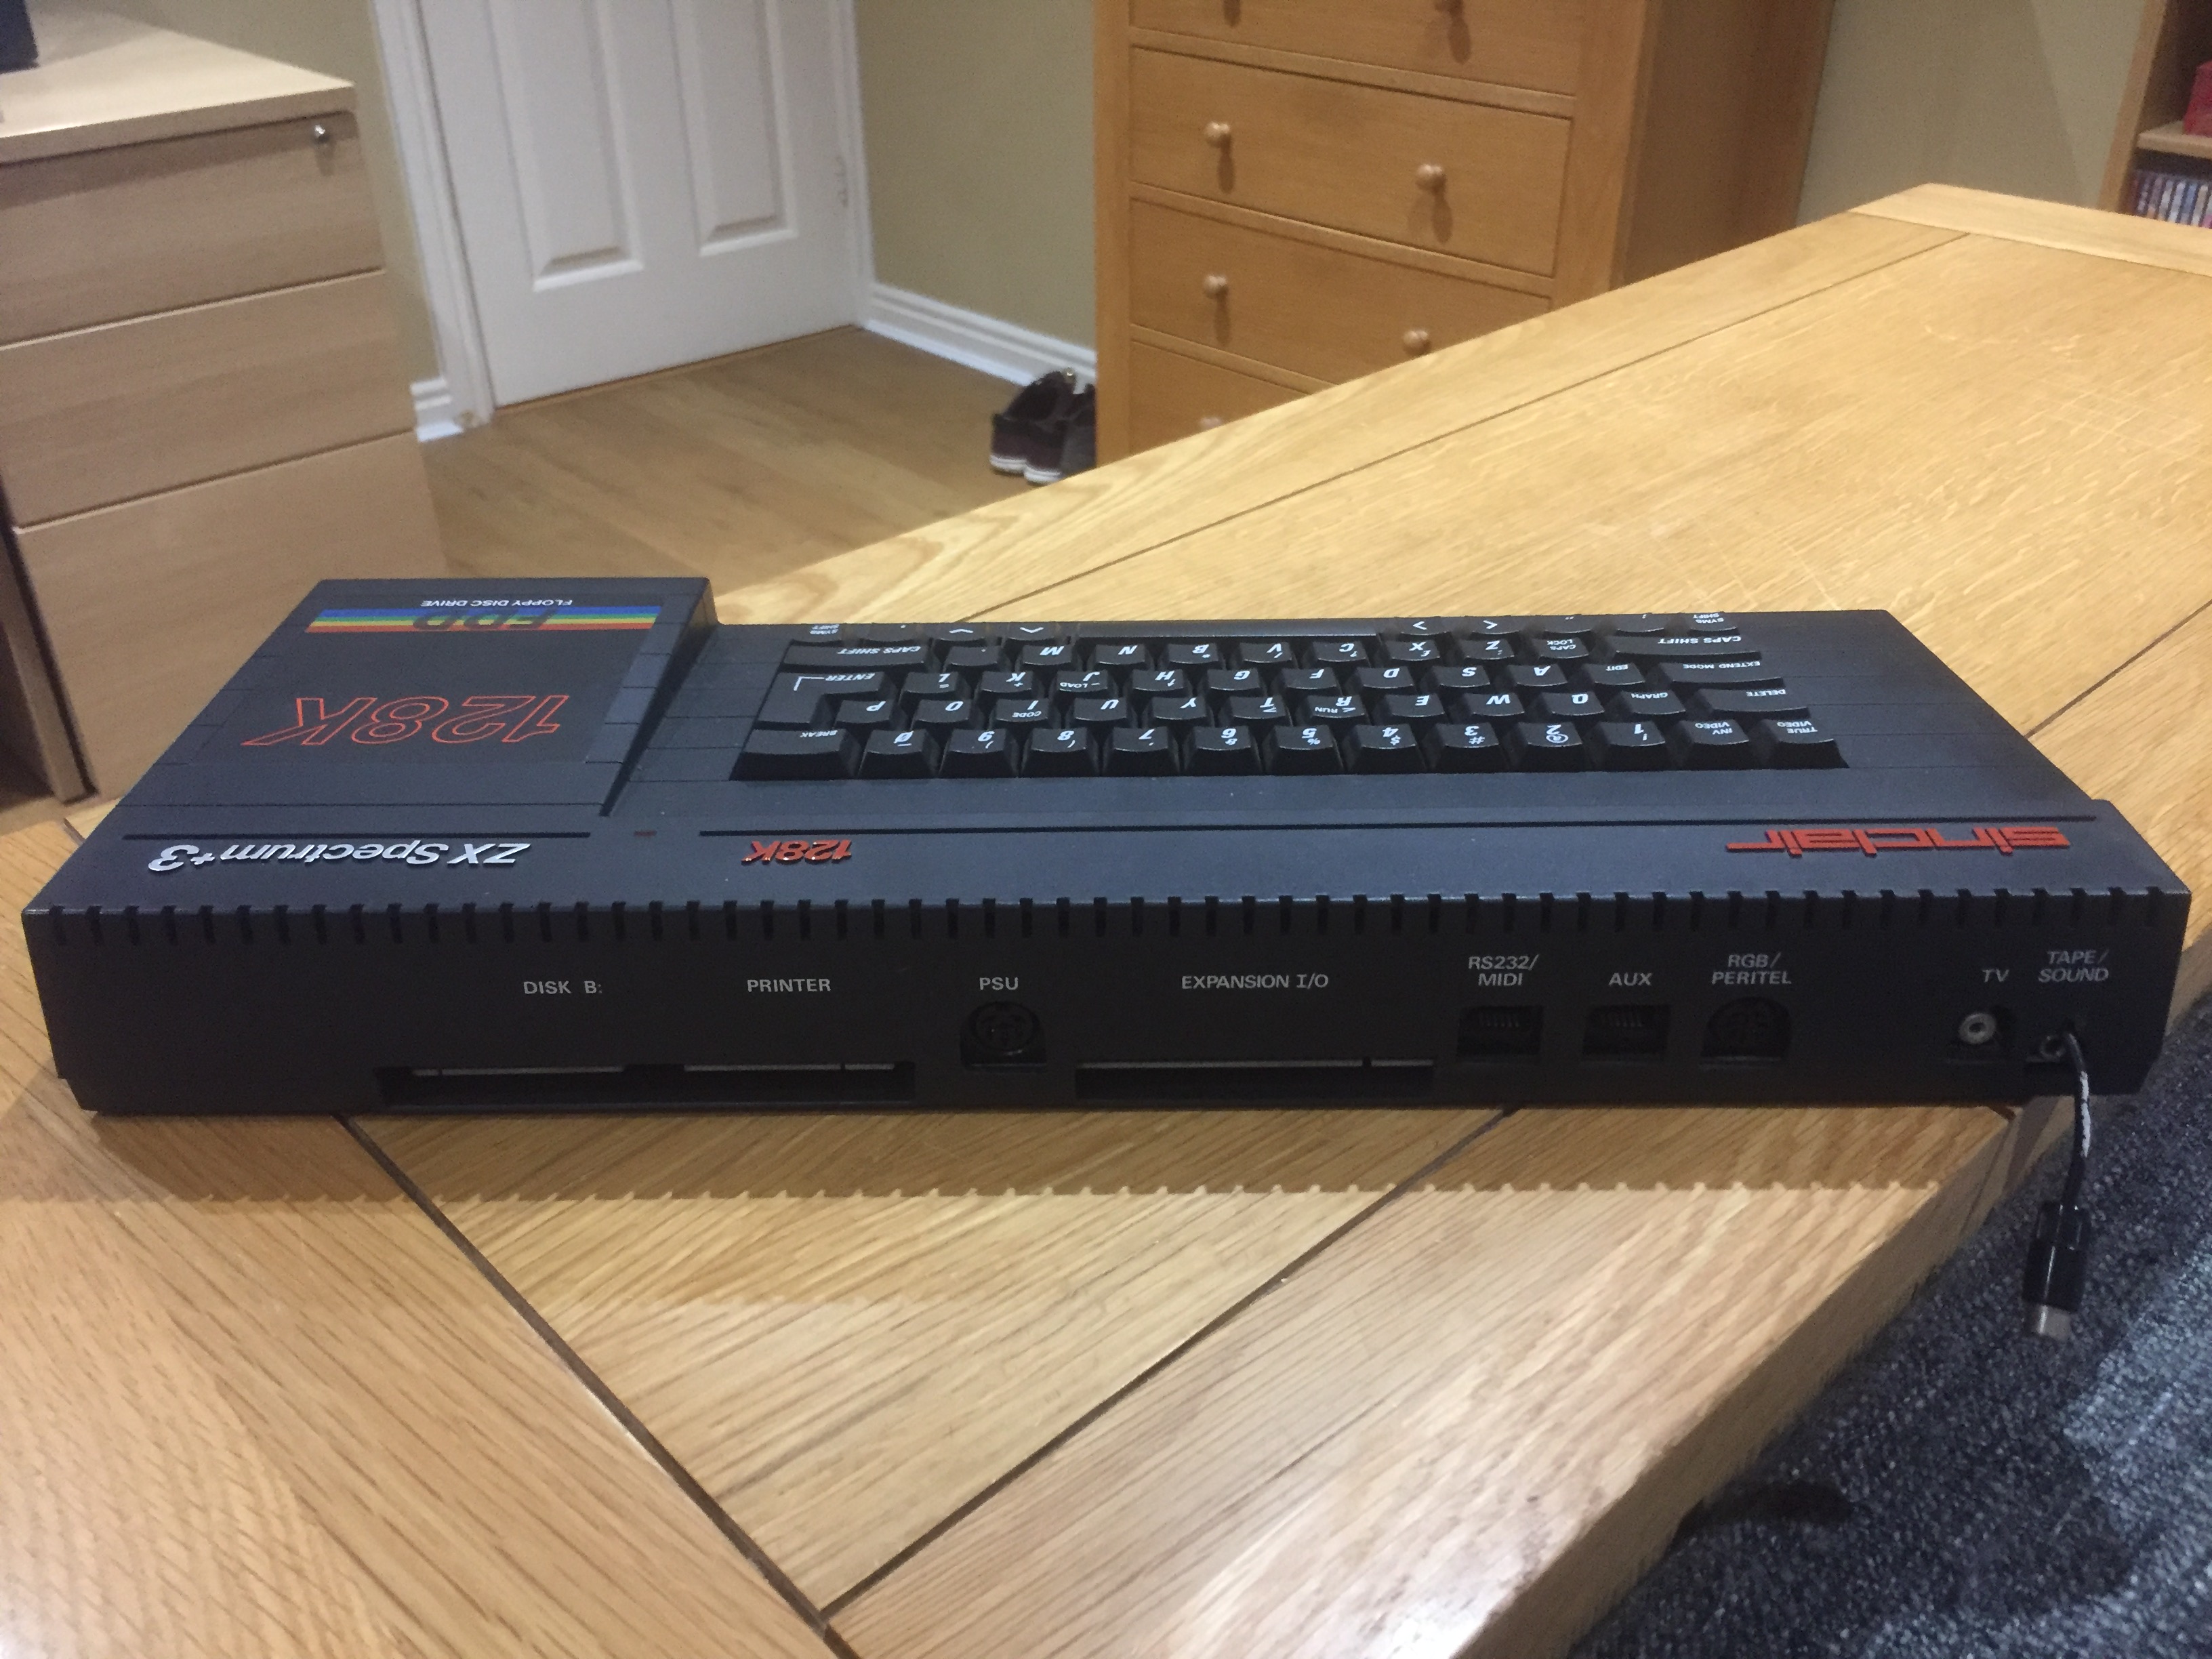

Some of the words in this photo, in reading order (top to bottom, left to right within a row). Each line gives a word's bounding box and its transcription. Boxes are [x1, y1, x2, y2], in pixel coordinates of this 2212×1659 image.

[1118, 645, 1137, 655] N
[1193, 644, 1209, 653] B
[1267, 644, 1282, 653] V
[1339, 643, 1354, 652] C
[1409, 642, 1426, 651] X
[1486, 640, 1500, 650] Z
[1040, 646, 1064, 655] M
[1155, 671, 1174, 680] H
[1234, 671, 1250, 680] G
[1310, 669, 1324, 678] F
[1384, 668, 1399, 678] D
[1462, 668, 1477, 676] S
[1534, 666, 1551, 676] A
[825, 673, 875, 681] ENTER
[939, 674, 950, 682] L
[1006, 672, 1025, 682] K
[1083, 672, 1100, 681] J
[1181, 698, 1196, 708] Y
[1260, 697, 1274, 708] T
[1336, 697, 1352, 706] R
[1416, 695, 1429, 705] E
[1486, 695, 1510, 704] W
[1572, 694, 1588, 703] Q
[866, 701, 886, 711] P
[945, 701, 963, 711] O
[1101, 699, 1119, 710] U
[242, 695, 569, 745] 128K
[1139, 729, 1154, 739] 7
[1221, 729, 1236, 738] 6
[1302, 728, 1317, 739] 5
[1382, 727, 1398, 737] 4
[1465, 726, 1479, 735] 3
[1547, 724, 1561, 735] 2
[1634, 724, 1644, 734] 1
[978, 731, 994, 741] 9
[1057, 731, 1074, 741] 8
[1726, 826, 2070, 857] sinclair
[447, 842, 531, 865] ZX
[742, 840, 851, 864] 128K
[1728, 953, 1780, 968] RGB/
[2049, 950, 2107, 964] TAPE/
[1469, 955, 1538, 970] RS232/
[1479, 973, 1522, 985] MIDI
[1609, 973, 1652, 985] AUX
[1712, 971, 1791, 984] PERITEL
[1983, 969, 2009, 982] TV
[2039, 968, 2108, 982] SOUND
[747, 979, 831, 991] PRINTER
[980, 977, 1018, 990] PSU
[1182, 975, 1289, 989] EXPANSION
[1297, 974, 1328, 989] I/O
[524, 981, 571, 994] DISK
[584, 981, 602, 993] B:
